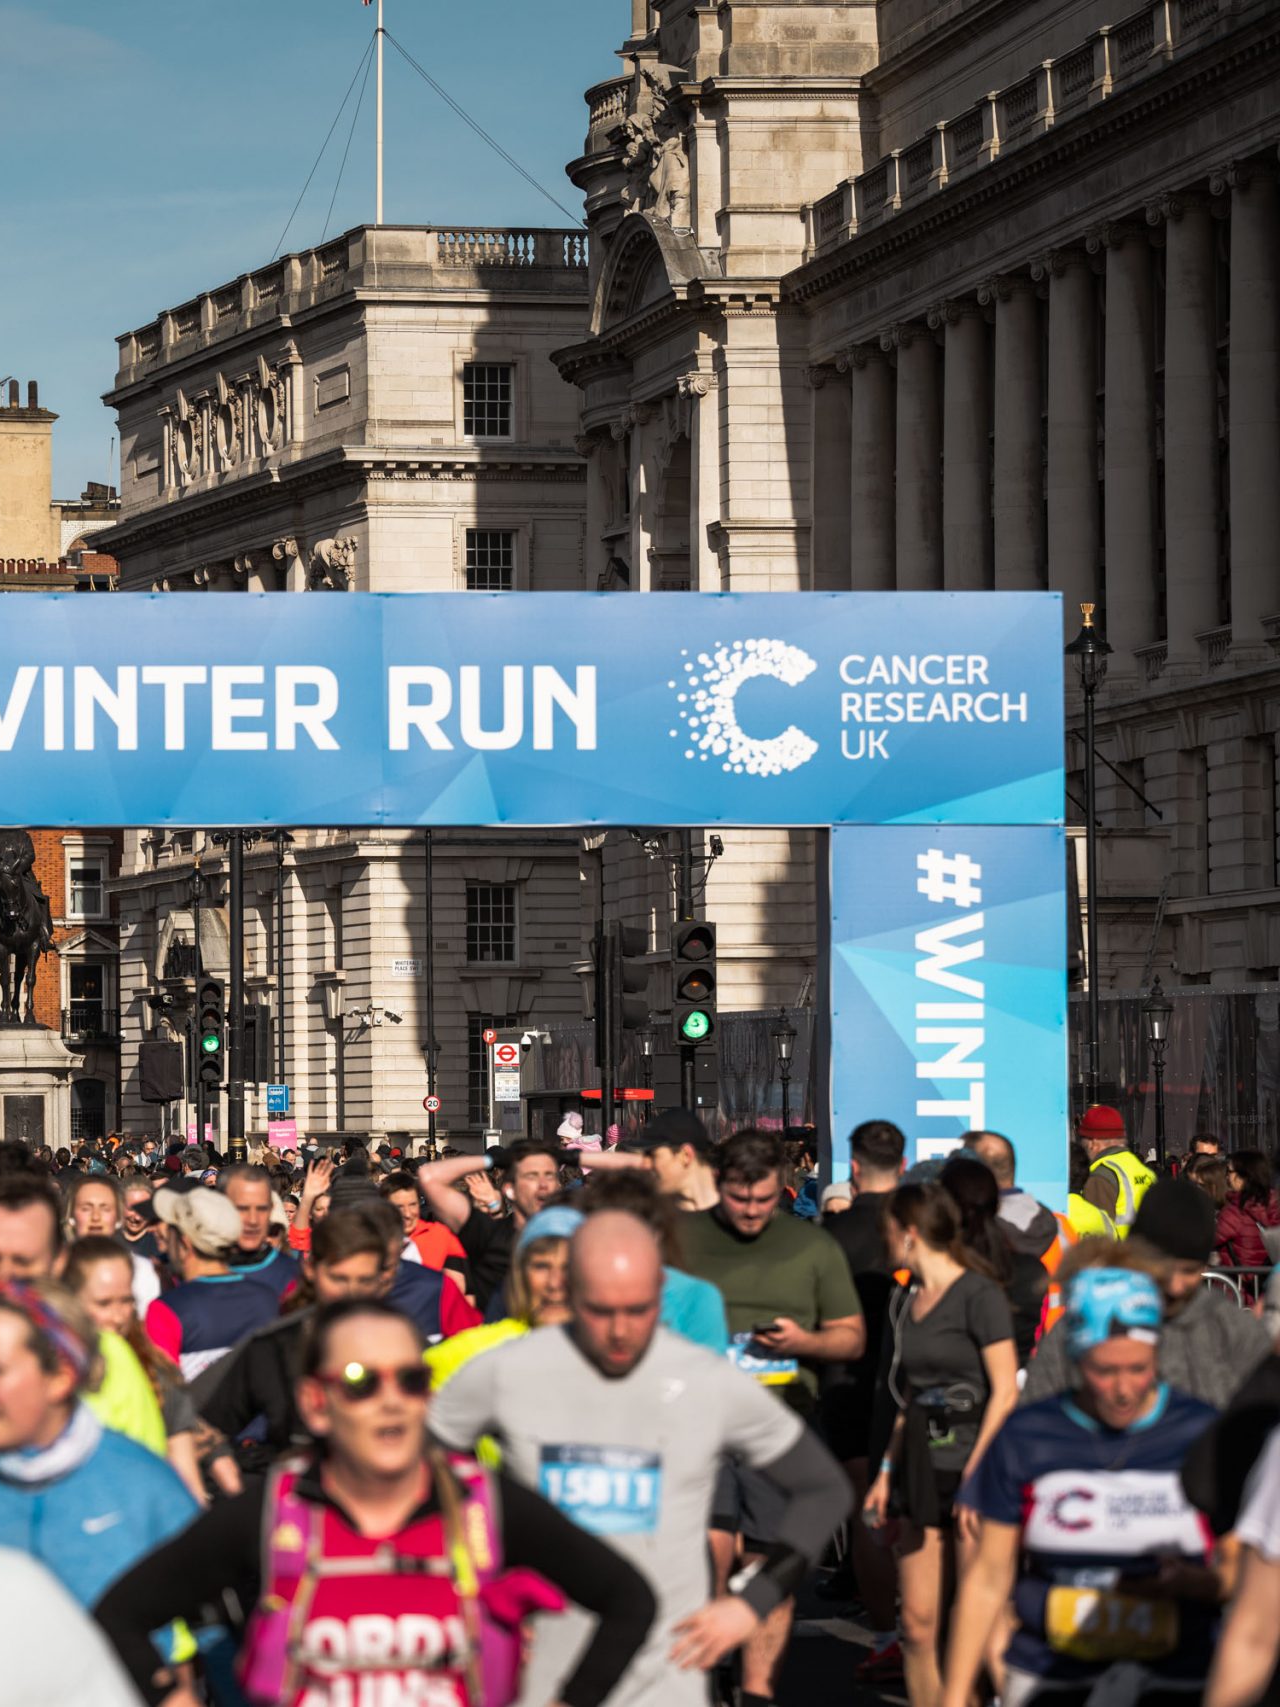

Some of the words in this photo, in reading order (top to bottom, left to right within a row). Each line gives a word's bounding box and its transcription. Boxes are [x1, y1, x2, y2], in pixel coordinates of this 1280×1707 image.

[838, 654, 989, 686] CANCER
[388, 665, 597, 751] RUN
[840, 691, 1028, 724] RESEARCH
[840, 730, 889, 760] UK
[486, 1031, 494, 1041] P
[427, 1099, 439, 1107] 20
